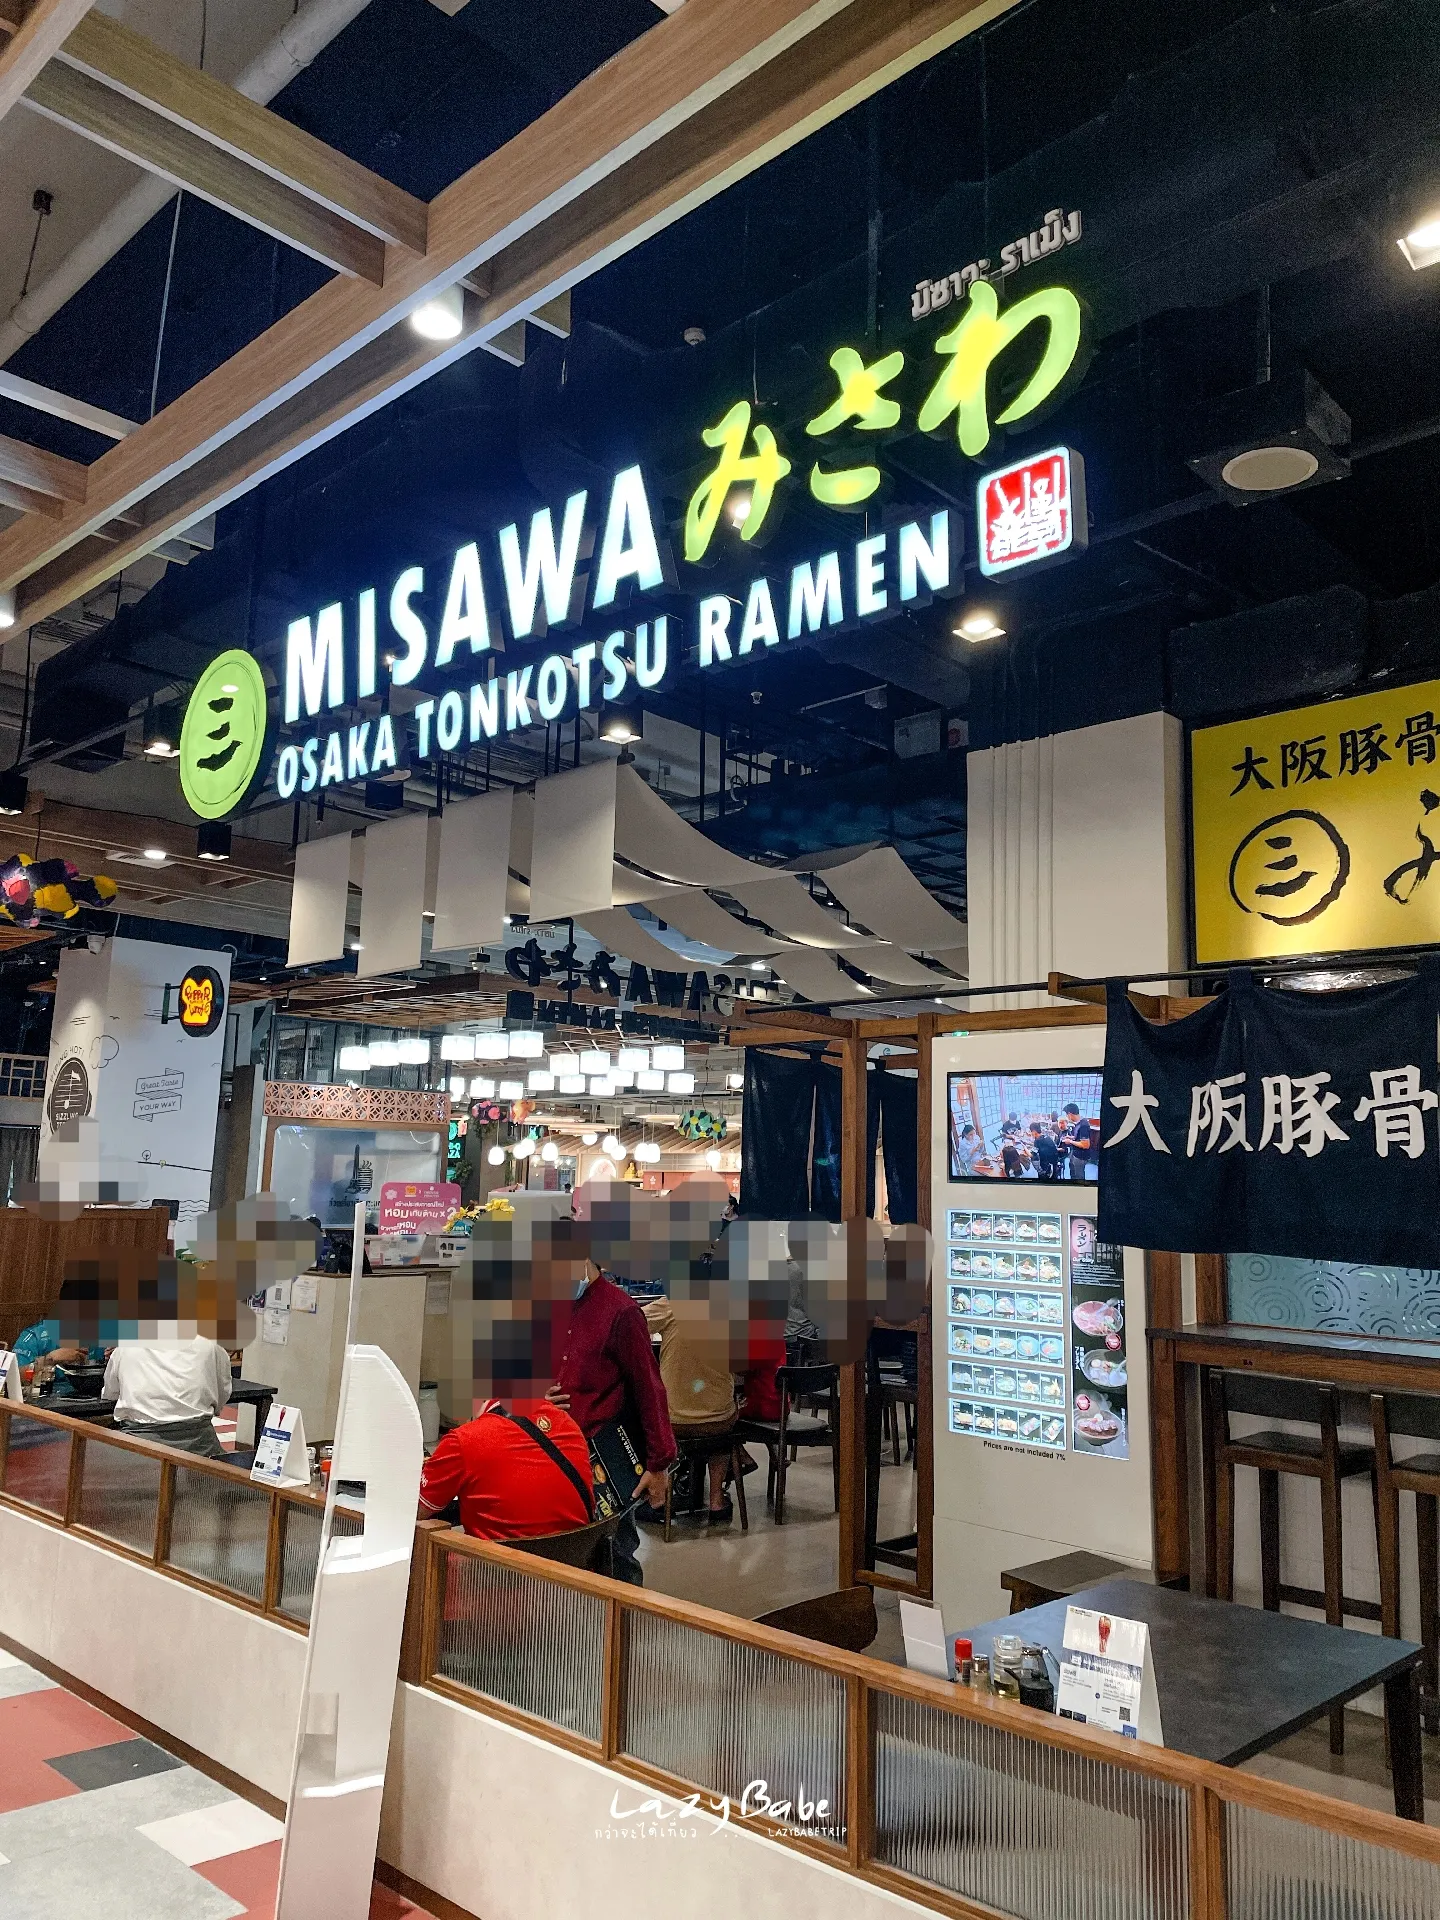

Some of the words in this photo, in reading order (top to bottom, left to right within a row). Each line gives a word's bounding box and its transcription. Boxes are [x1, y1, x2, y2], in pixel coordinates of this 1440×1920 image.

[684, 280, 1081, 561] みさわ
[284, 463, 664, 724] MISAWA
[277, 714, 396, 799] OSAKA
[415, 615, 668, 758] TONKOTSU
[700, 509, 950, 668] RAMEN
[1229, 710, 1440, 797] 大阪豚骨
[139, 1103, 160, 1111] YOUR
[161, 1100, 177, 1109] WAY
[140, 1080, 160, 1091] Great
[1103, 1064, 1439, 1159] 大阪豚骨
[983, 1440, 1002, 1450] Prices
[1027, 1448, 1054, 1459] included
[1056, 1452, 1066, 1461] 7%
